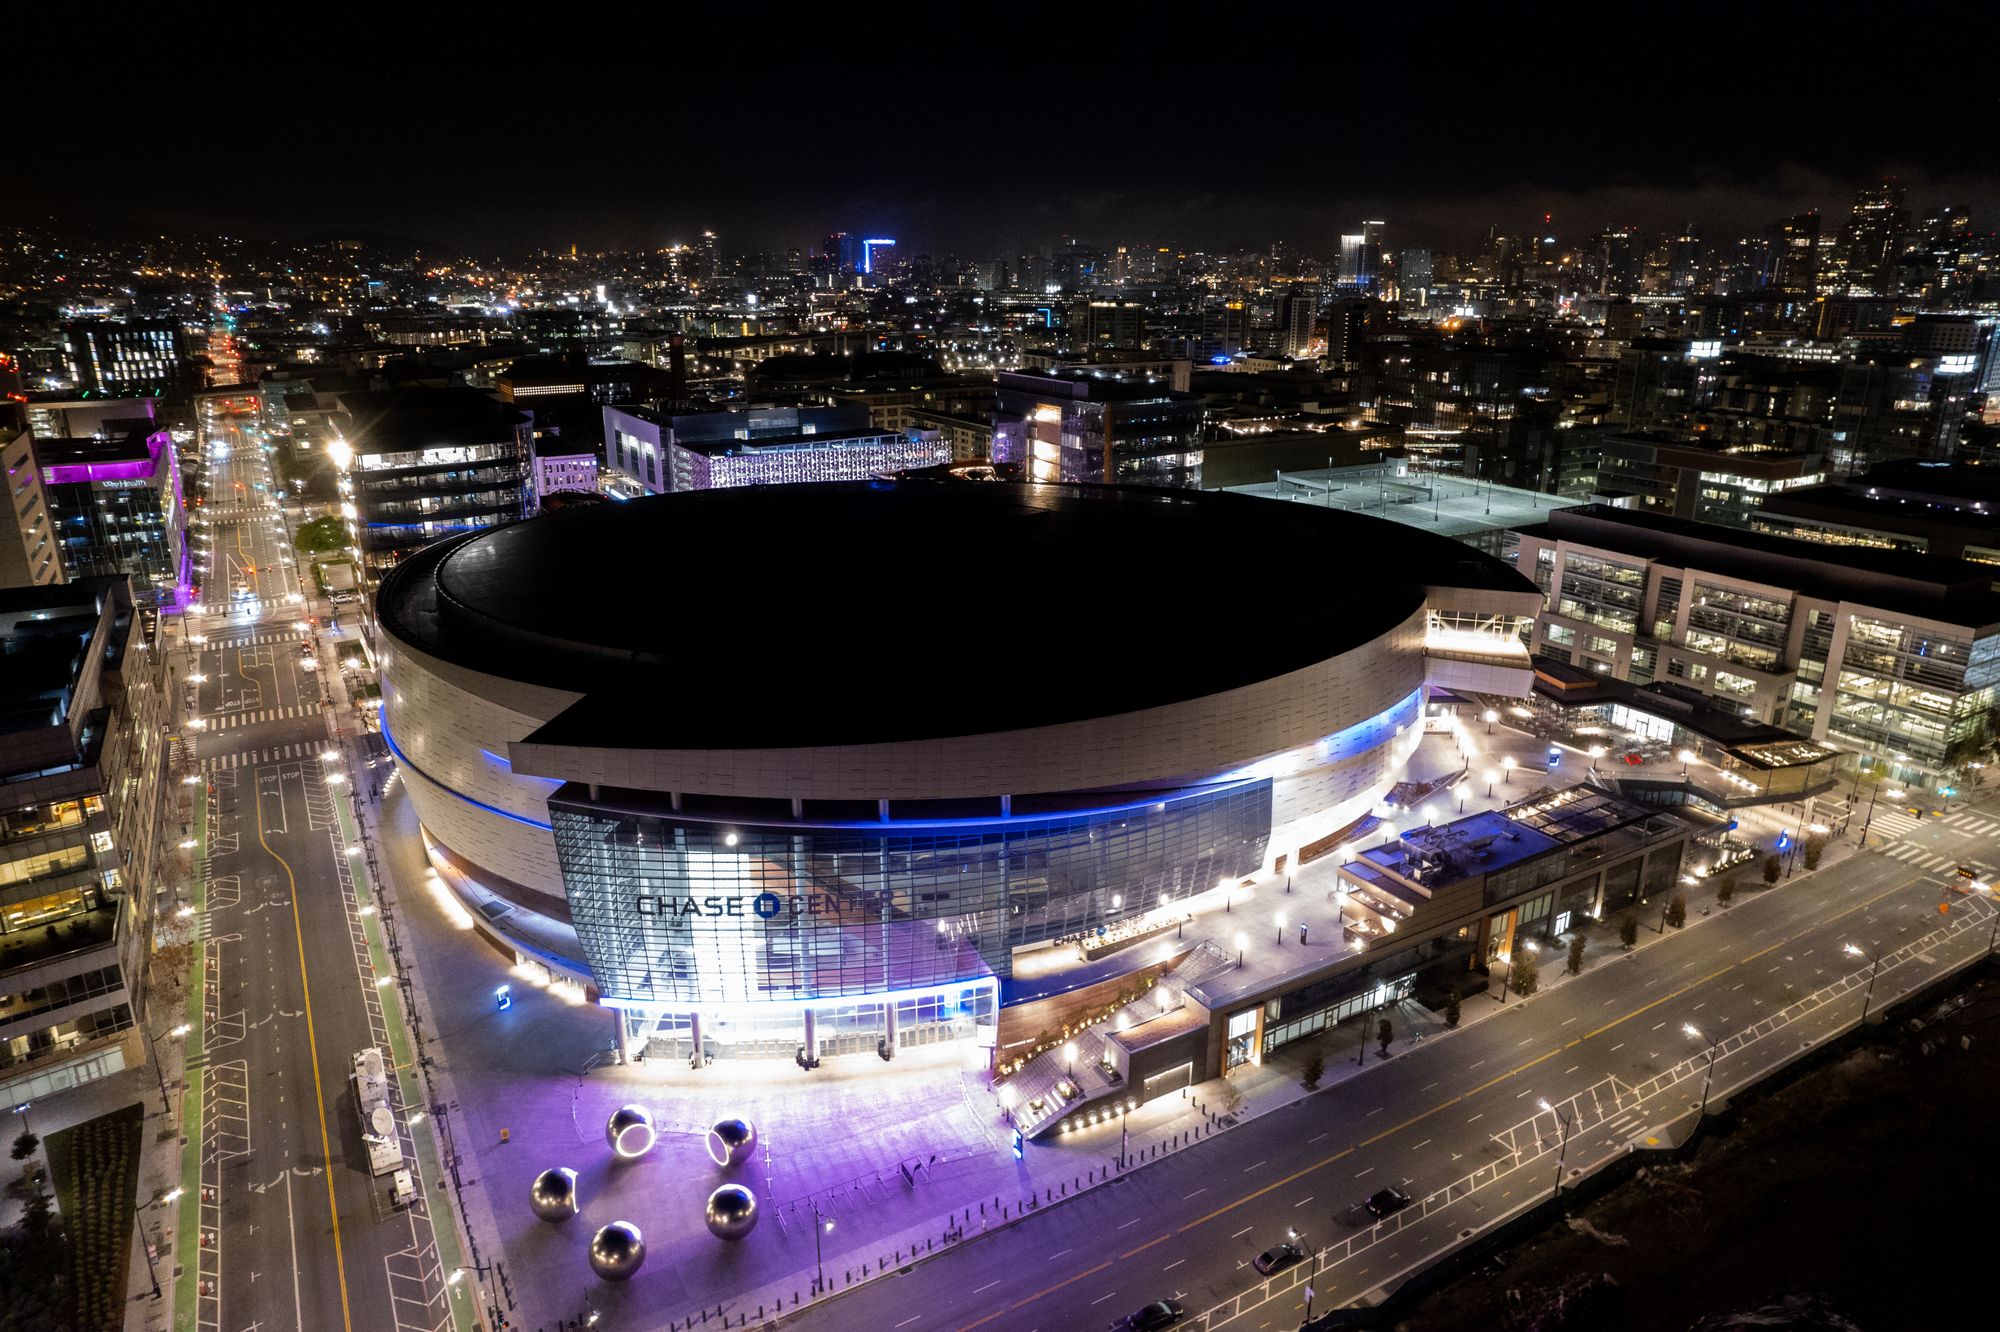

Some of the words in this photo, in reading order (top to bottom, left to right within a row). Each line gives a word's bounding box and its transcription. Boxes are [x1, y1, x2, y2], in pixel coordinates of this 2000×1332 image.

[260, 775, 277, 783] STOP
[282, 771, 300, 780] STOP
[636, 895, 745, 917] CHASE
[788, 889, 894, 915] CENTER
[1053, 929, 1095, 947] CHASE
